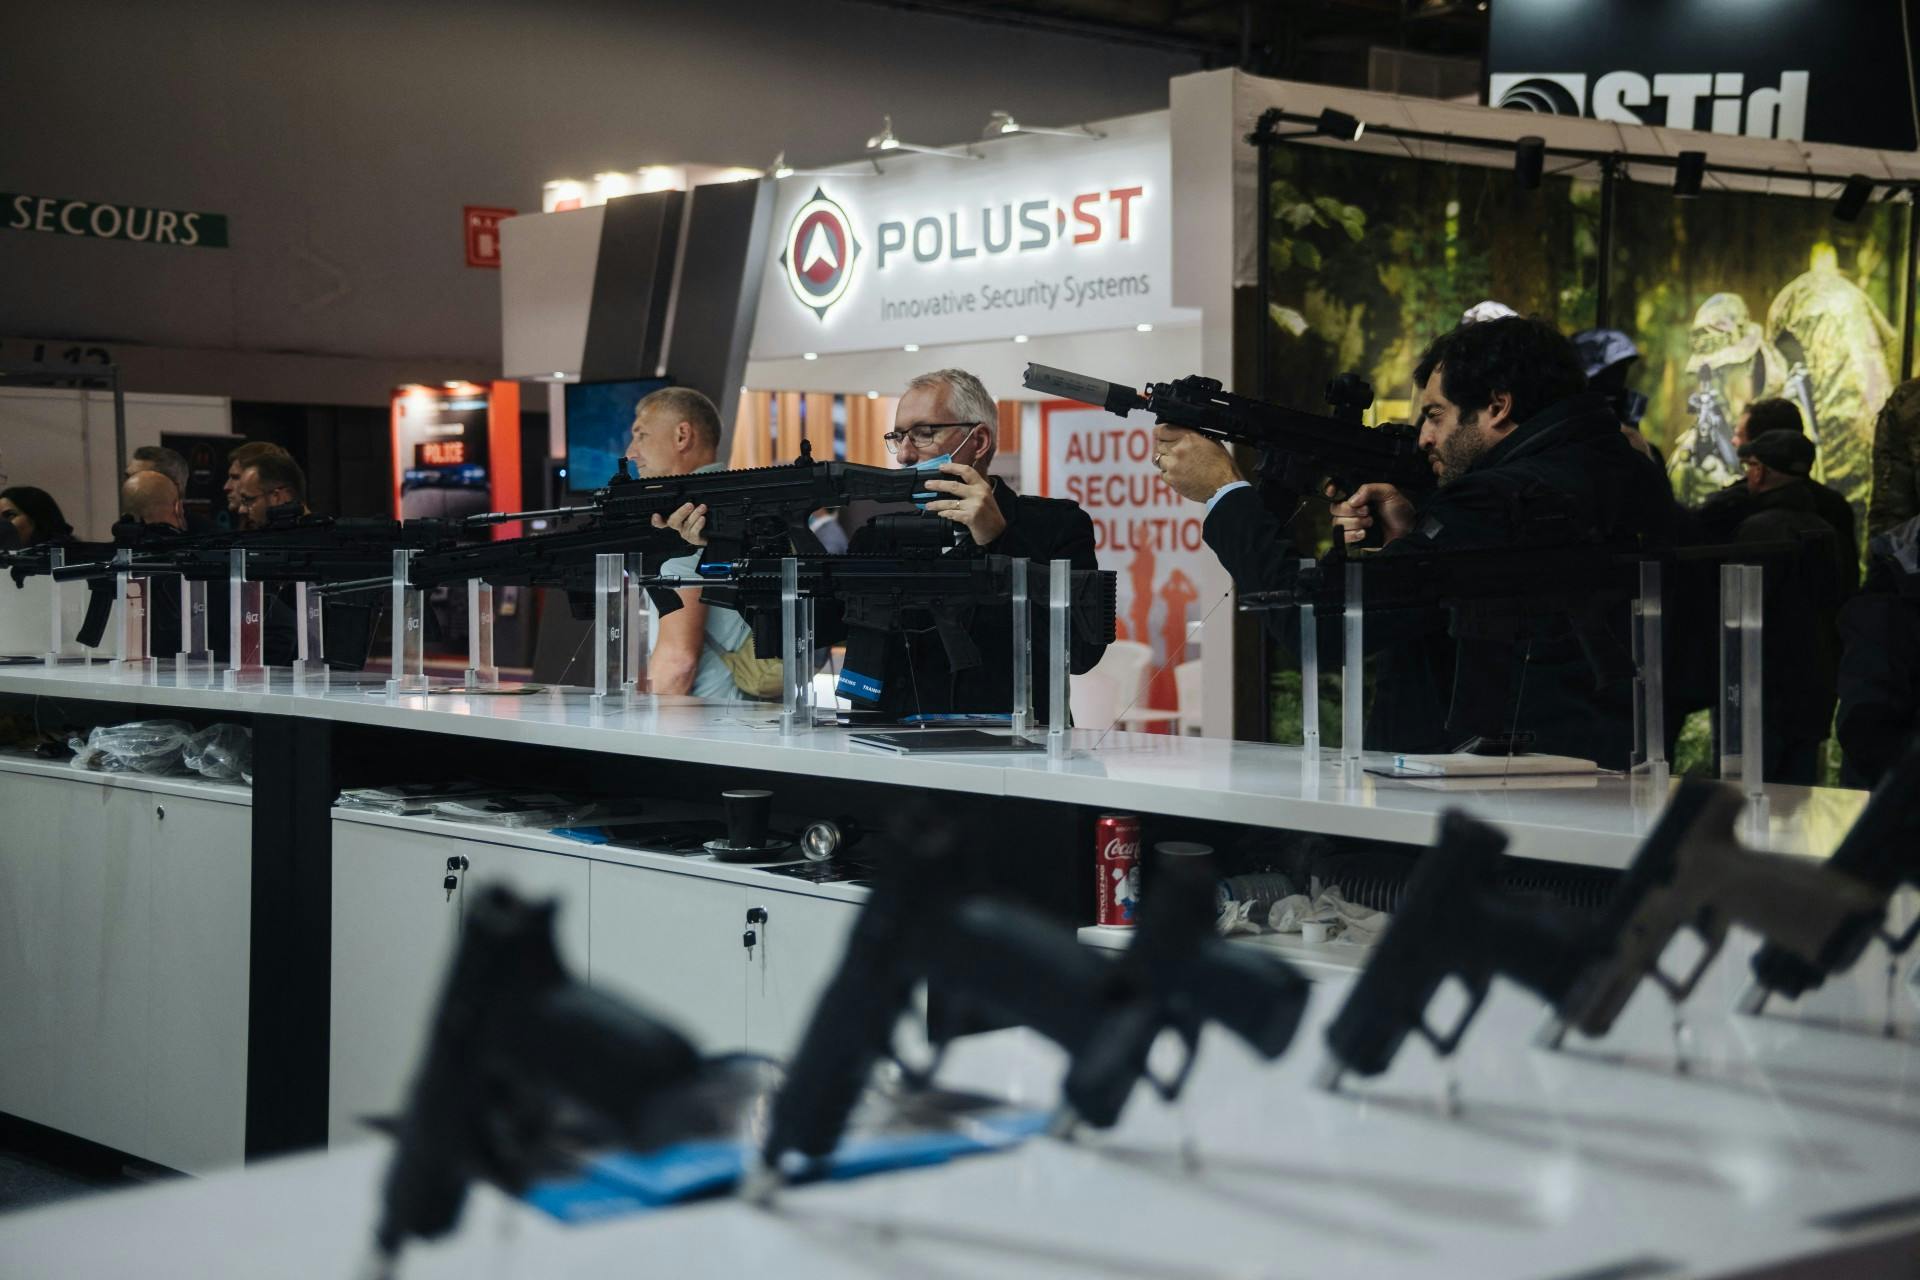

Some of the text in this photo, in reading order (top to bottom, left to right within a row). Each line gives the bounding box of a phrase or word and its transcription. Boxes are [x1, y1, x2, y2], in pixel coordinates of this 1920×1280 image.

[1592, 70, 1810, 142] STid
[10, 194, 200, 246] SECOURS
[877, 186, 1143, 269] POLUS ST
[881, 273, 1150, 320] Innovative Security Systems
[1065, 428, 1157, 463] AUTO
[1092, 518, 1202, 552] OLUTIO
